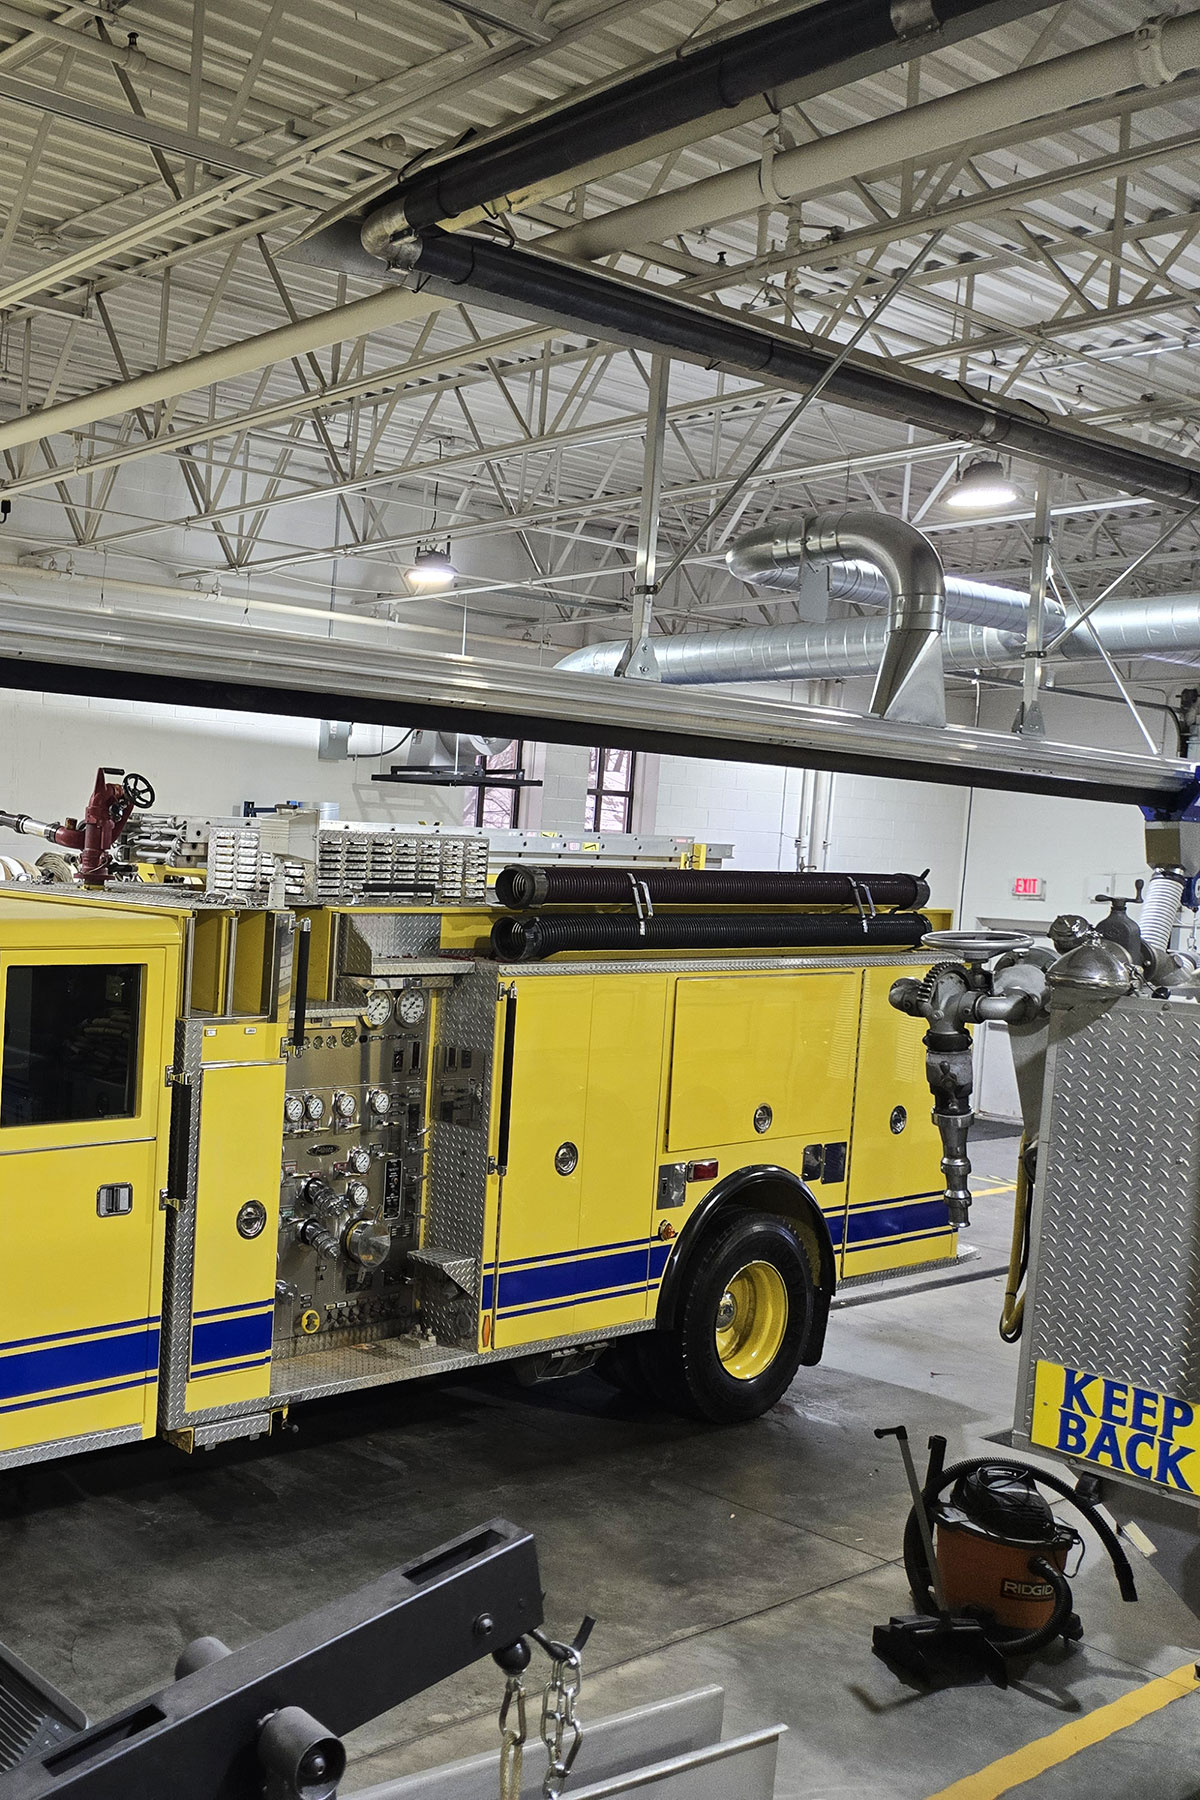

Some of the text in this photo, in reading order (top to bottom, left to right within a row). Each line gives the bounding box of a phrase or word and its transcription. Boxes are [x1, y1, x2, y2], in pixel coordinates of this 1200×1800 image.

[1015, 877, 1038, 894] EXIT
[1061, 1368, 1194, 1441] KEEP
[1056, 1408, 1196, 1492] BACK
[1003, 1581, 1054, 1596] RIDGID
